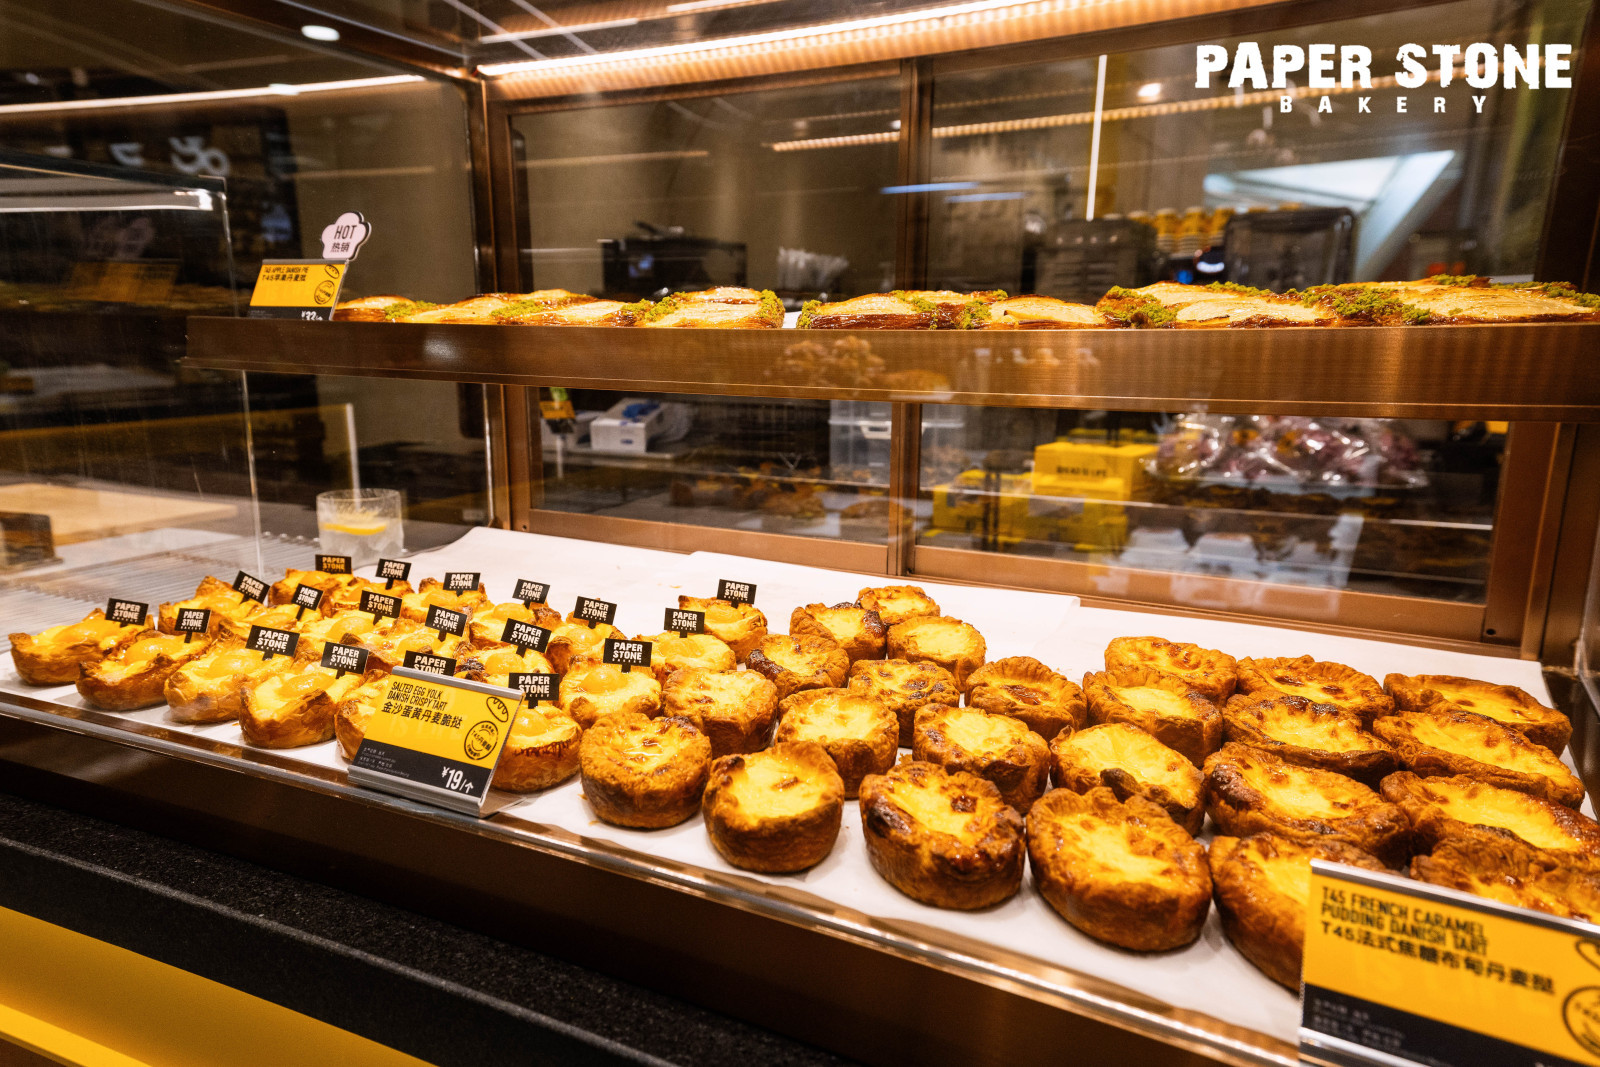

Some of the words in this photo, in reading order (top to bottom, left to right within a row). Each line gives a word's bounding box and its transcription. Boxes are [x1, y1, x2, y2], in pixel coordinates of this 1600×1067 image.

[334, 225, 357, 240] HOT
[330, 242, 351, 253] 热销
[321, 556, 345, 564] PAPER
[321, 563, 345, 571] STONE
[383, 561, 405, 571] PAPER
[382, 567, 404, 577] STONE
[450, 573, 474, 581] PAPER
[242, 575, 264, 591] PAPER
[449, 580, 473, 588] STONE
[522, 582, 544, 592] PAPER
[725, 582, 750, 593] PAPER
[239, 581, 262, 597] STONE
[300, 587, 318, 598] PAPER
[520, 589, 542, 599] STONE
[724, 589, 749, 599] STONE
[297, 594, 316, 605] STONE
[368, 594, 395, 606] PAPER
[114, 602, 141, 613] PAPER
[367, 601, 394, 613] STONE
[583, 599, 609, 612] PAPER
[113, 609, 140, 620] STONE
[183, 610, 205, 620] PAPER
[435, 609, 460, 622] PAPER
[582, 607, 608, 619] STONE
[672, 611, 698, 621] PAPER
[181, 618, 203, 627] STONE
[433, 616, 458, 630] STONE
[671, 618, 697, 628] STONE
[514, 622, 543, 637] PAPER
[258, 629, 290, 642] PAPER
[511, 631, 540, 645] STONE
[256, 637, 288, 650] STONE
[613, 642, 643, 652] PAPER
[332, 645, 360, 658] PAPER
[612, 650, 642, 661] STONE
[330, 654, 358, 667] STONE
[414, 655, 447, 668] PAPER
[413, 664, 445, 675] STONE
[518, 675, 550, 685] PAPER
[392, 681, 412, 694] SALTED
[413, 686, 426, 696] EGG
[427, 688, 443, 700] YOLK
[518, 684, 550, 694] STONE
[387, 692, 409, 705] DANISH
[409, 696, 431, 708] CRISPY
[432, 700, 448, 711] TART
[381, 701, 463, 730] 金沙蛋黄丹麦脆挞
[1322, 886, 1347, 905] T45
[1351, 893, 1409, 920] FRENCH
[1412, 908, 1485, 934] CARAMEL
[1321, 902, 1385, 931] PUDDING
[1389, 919, 1447, 947] DANISH
[1452, 932, 1489, 956] TART
